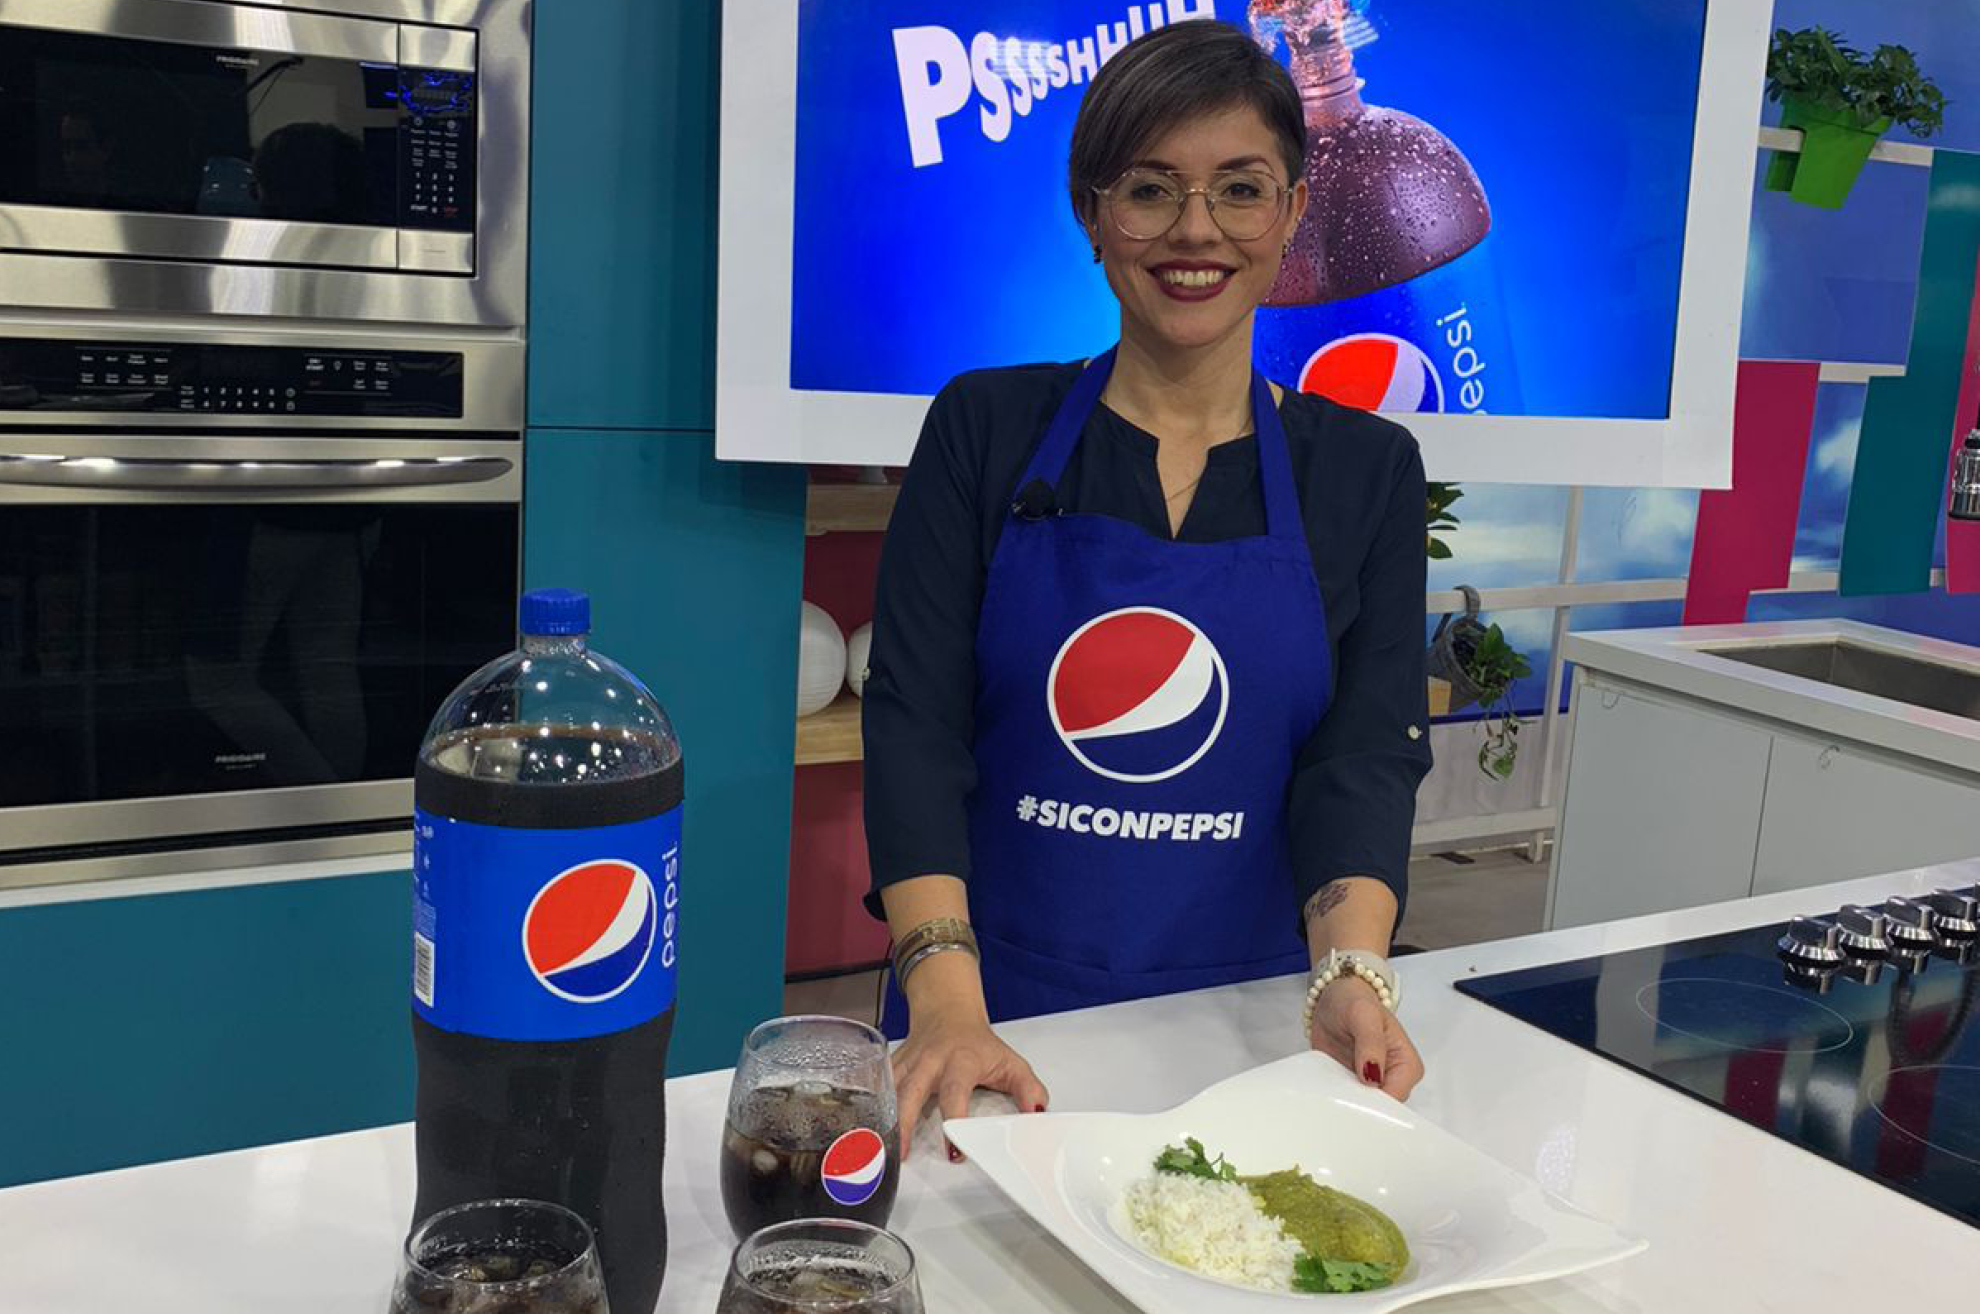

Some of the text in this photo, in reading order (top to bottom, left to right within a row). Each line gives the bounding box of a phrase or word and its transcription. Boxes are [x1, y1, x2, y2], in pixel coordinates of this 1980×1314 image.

[892, 0, 1215, 168] PSSSSHH
[1436, 307, 1488, 416] epsi
[1016, 794, 1244, 840] #SICONPEPSI
[661, 846, 679, 968] pepsi
